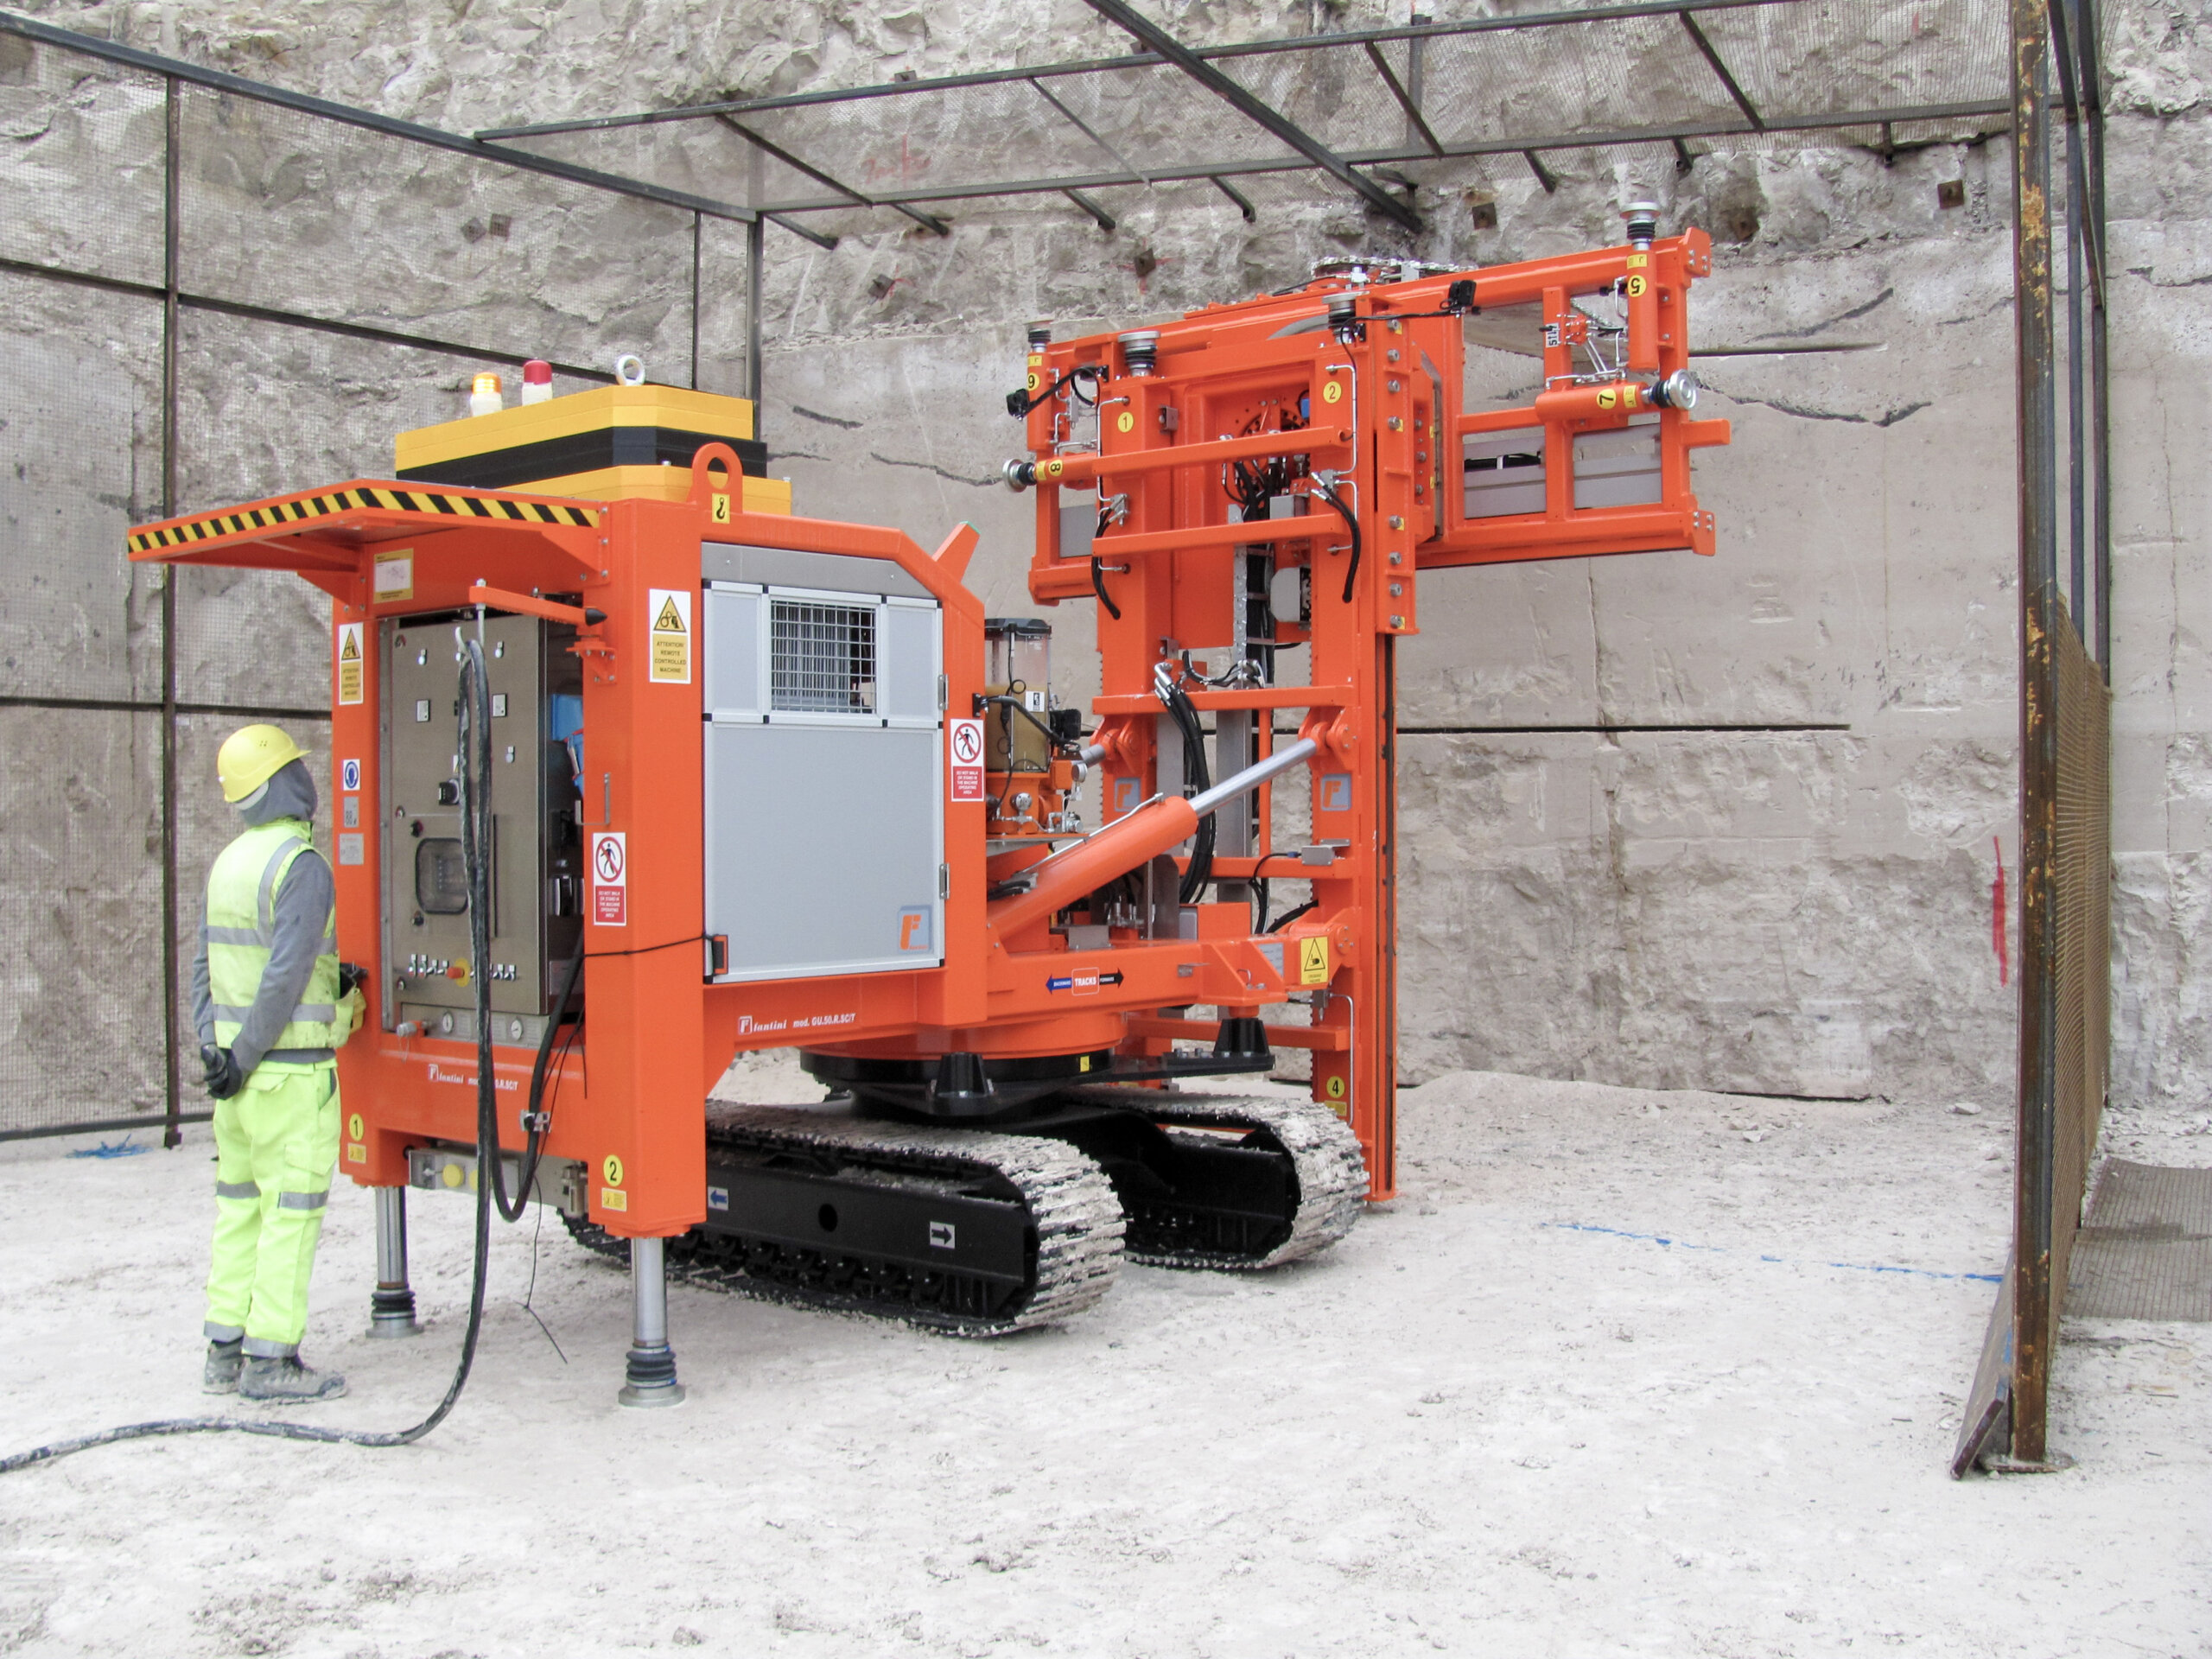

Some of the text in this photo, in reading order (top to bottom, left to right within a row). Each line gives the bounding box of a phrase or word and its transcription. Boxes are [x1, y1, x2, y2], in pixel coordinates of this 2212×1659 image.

[1329, 385, 1336, 400] 2
[1050, 462, 1061, 472] 8
[1074, 976, 1096, 987] TRACKS
[1332, 1080, 1338, 1095] 4
[609, 1160, 617, 1181] 2
